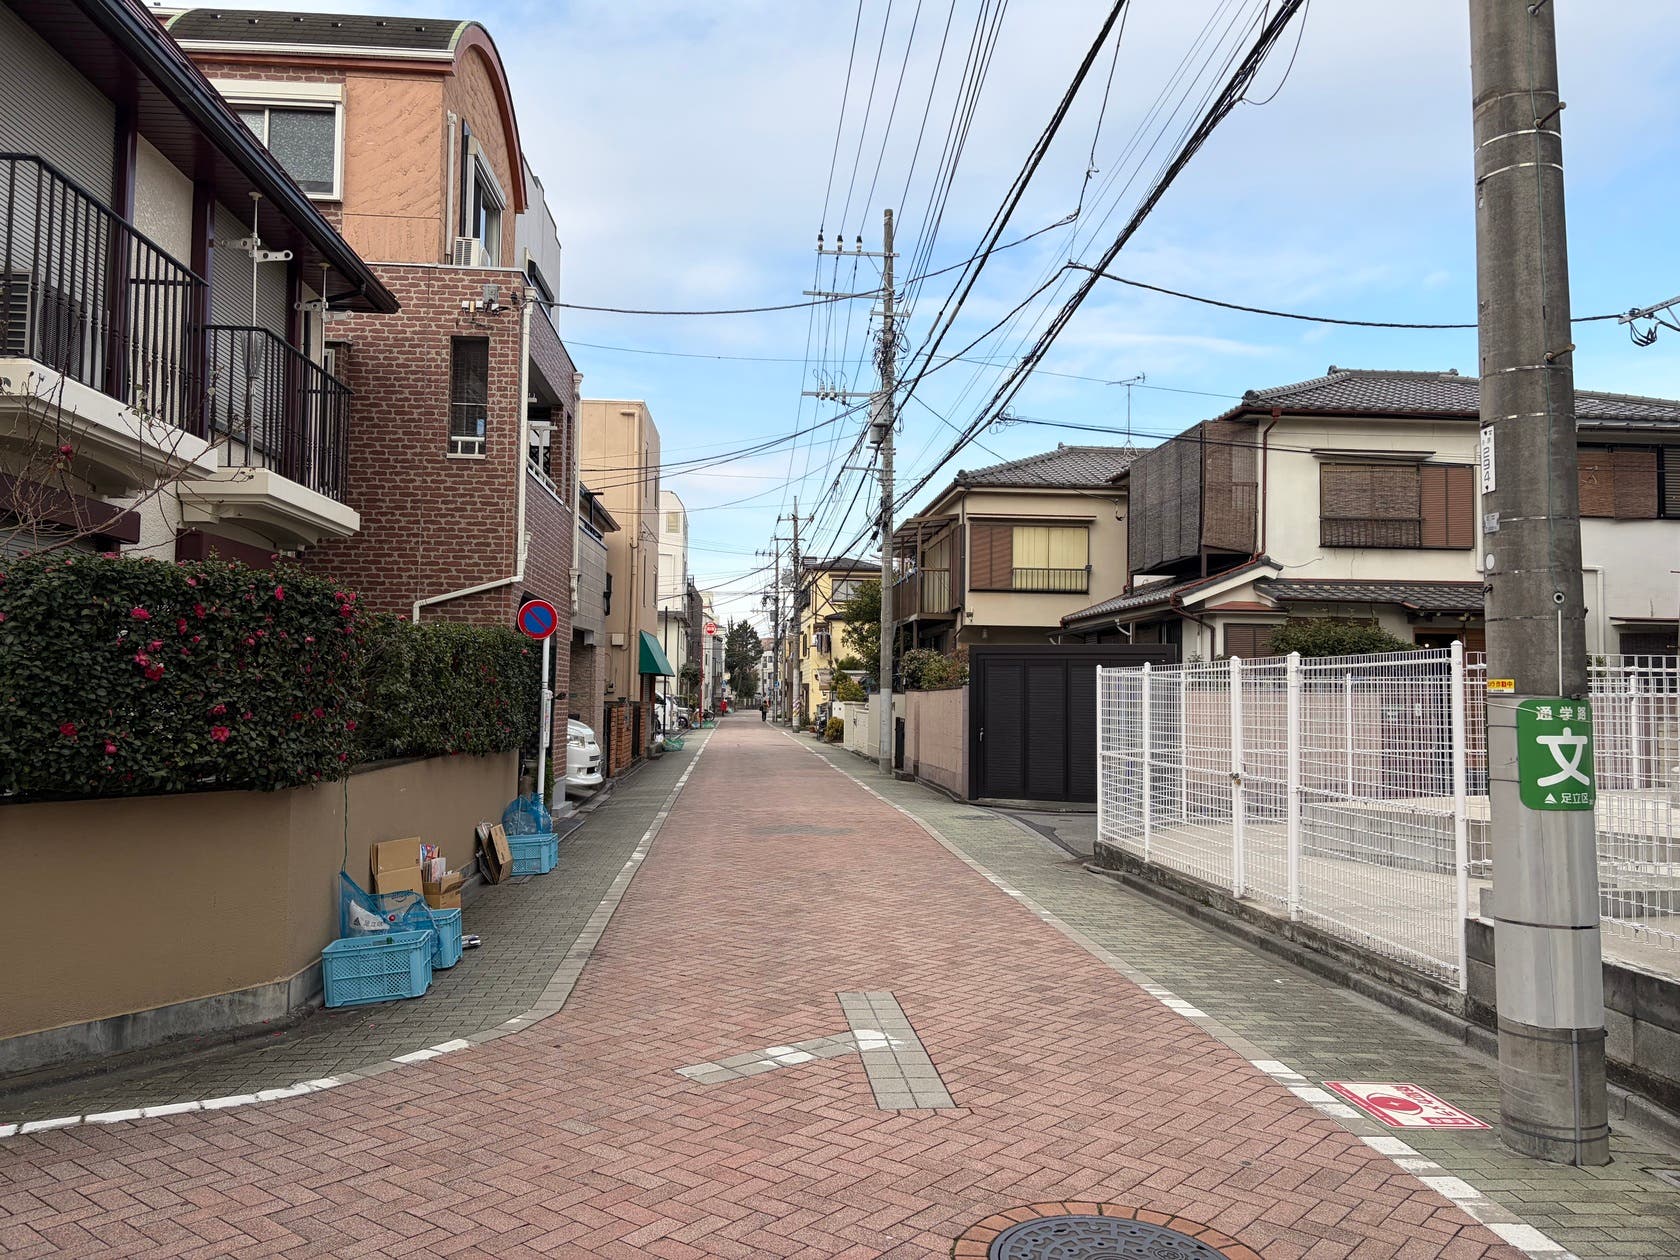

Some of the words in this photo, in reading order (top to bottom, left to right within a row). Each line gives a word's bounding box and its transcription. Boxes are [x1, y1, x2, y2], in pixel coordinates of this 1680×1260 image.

[1536, 706, 1586, 720] 通学路
[1536, 727, 1590, 787] 文
[1561, 793, 1588, 804] 足立区
